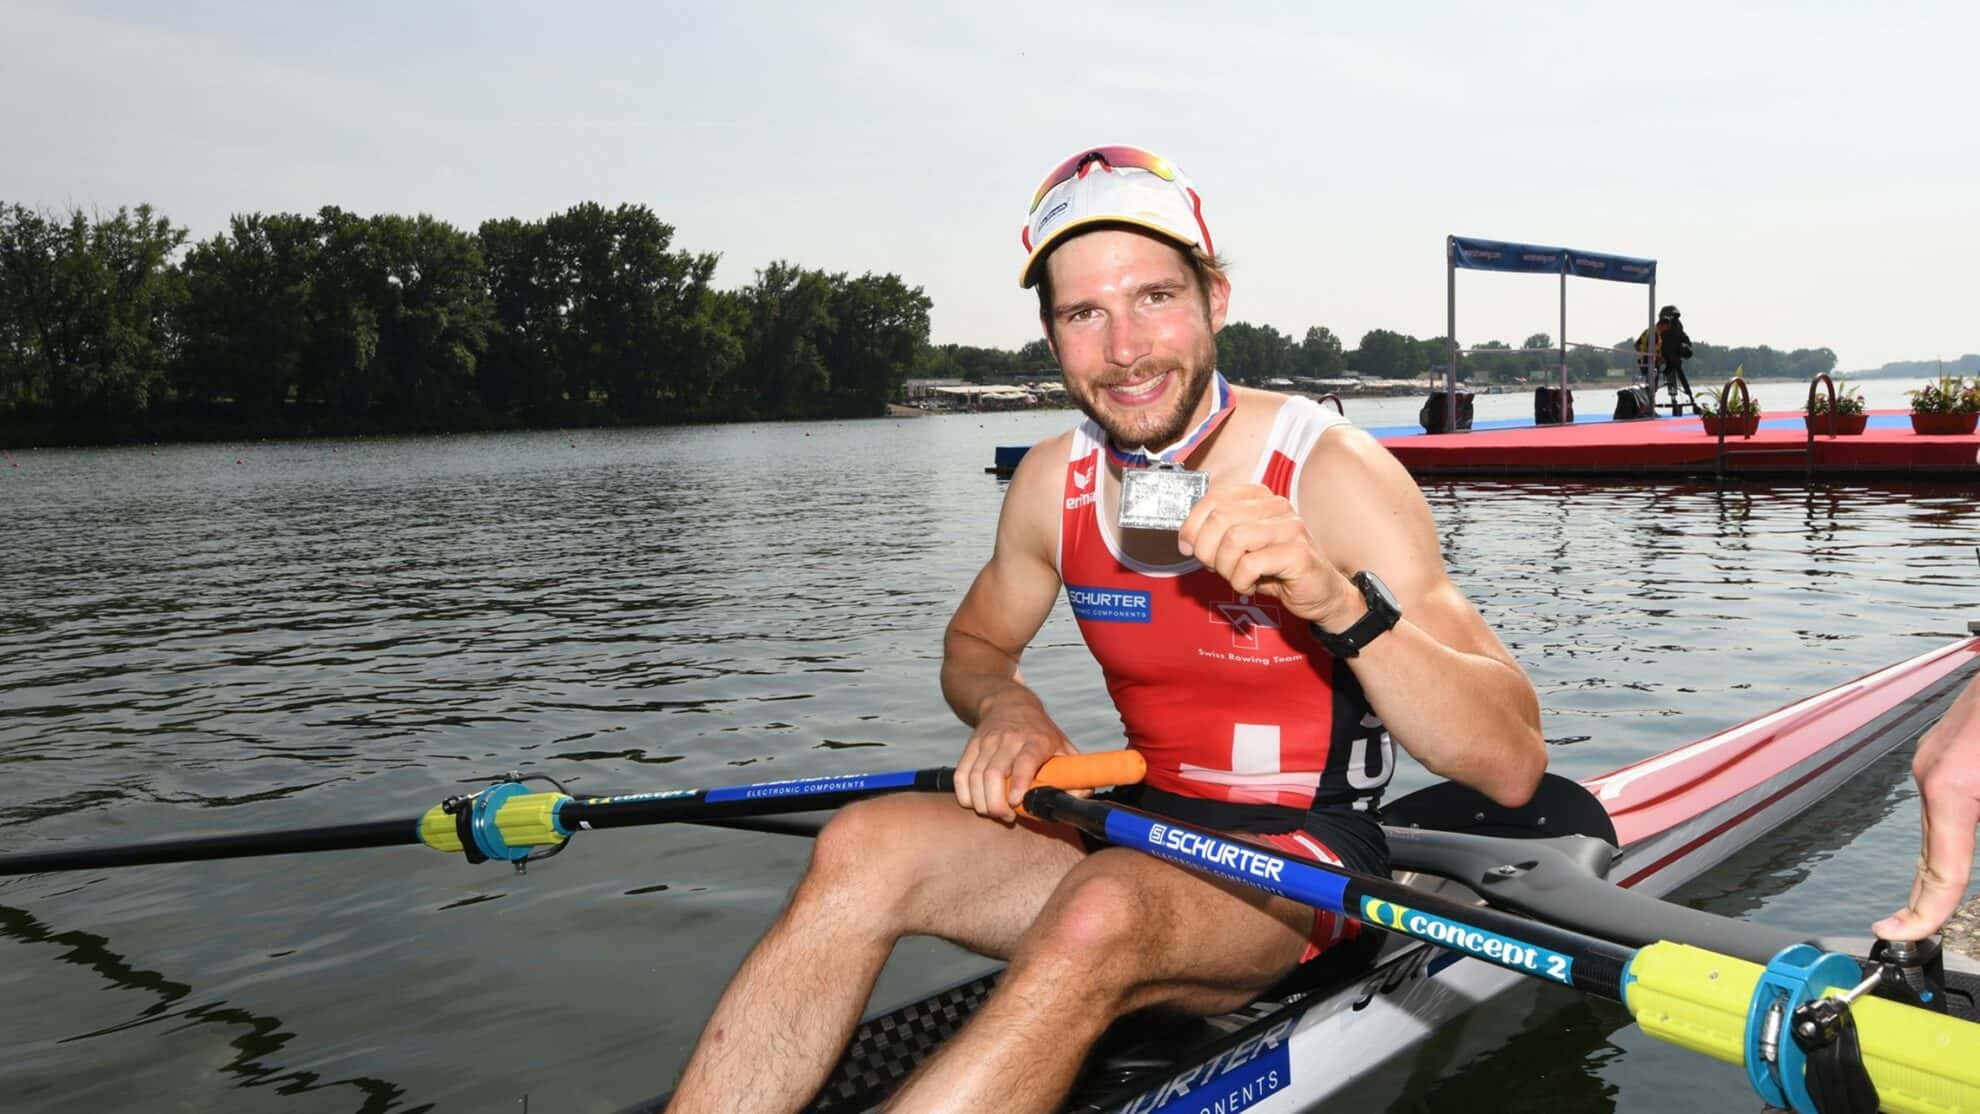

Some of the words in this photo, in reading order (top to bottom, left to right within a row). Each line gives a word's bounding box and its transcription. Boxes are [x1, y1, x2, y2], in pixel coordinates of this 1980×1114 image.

[1070, 590, 1147, 608] SCHURTER
[1198, 648, 1225, 659] Swiss
[1228, 653, 1270, 665] Rowing
[1273, 655, 1302, 663] Team
[746, 785, 801, 798] ELECTRONIC
[804, 780, 865, 792] COMPONENTS
[1166, 829, 1285, 882] SCHURTER
[1409, 914, 1538, 970] concept
[1546, 955, 1567, 979] 2
[1120, 1018, 1293, 1114] URTER
